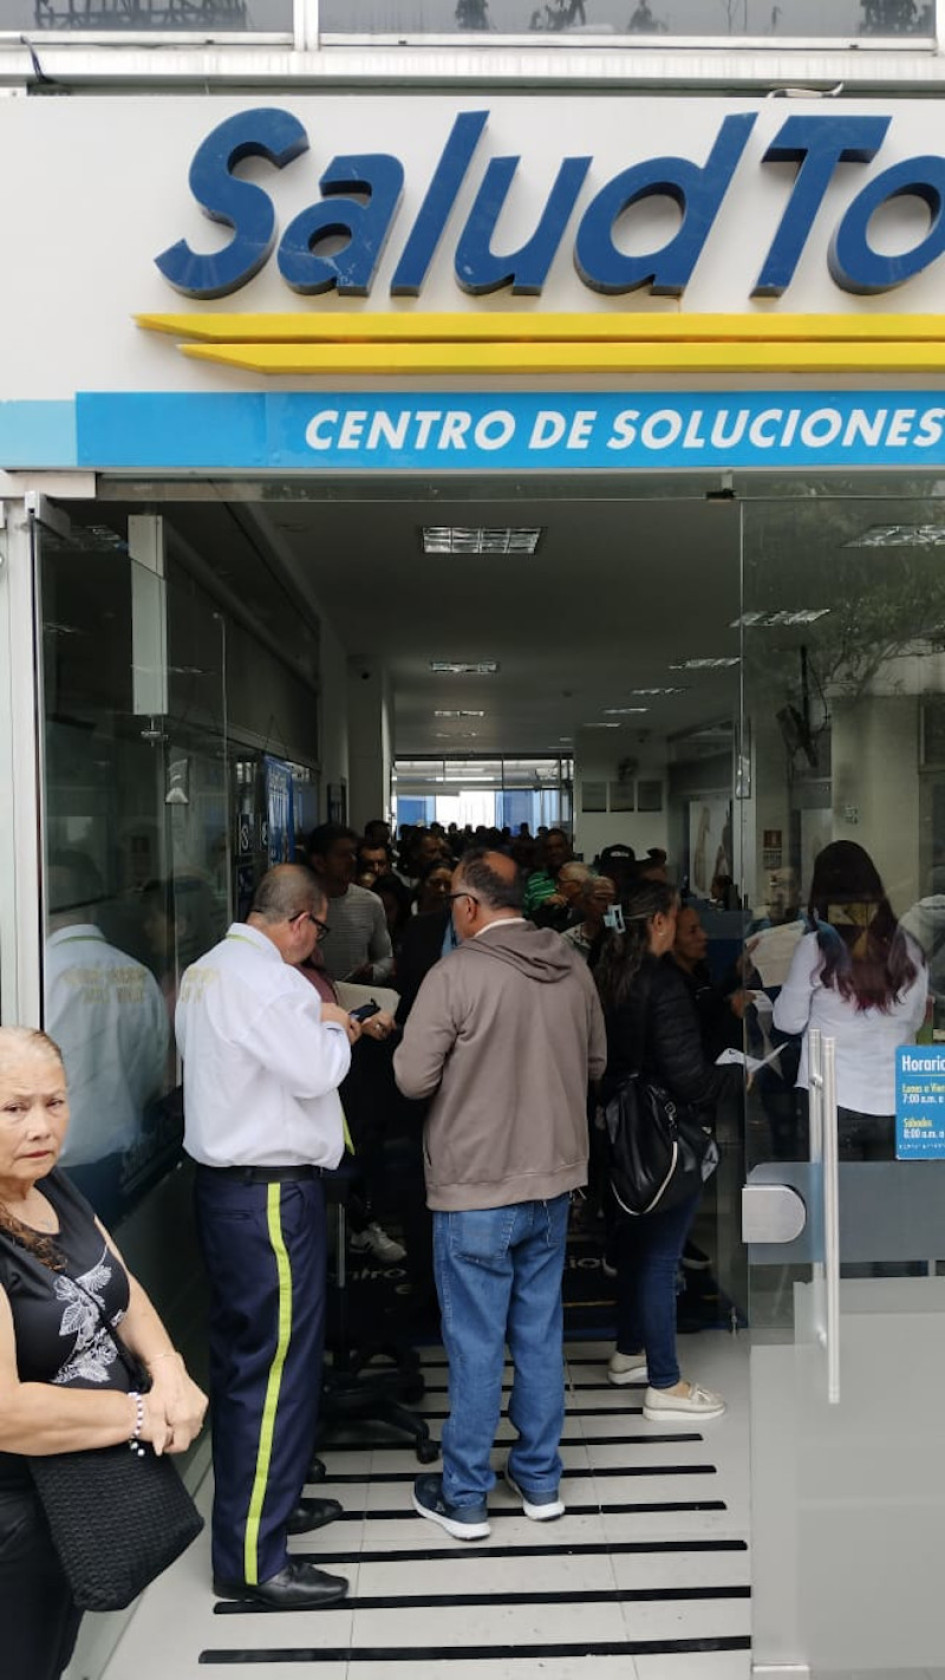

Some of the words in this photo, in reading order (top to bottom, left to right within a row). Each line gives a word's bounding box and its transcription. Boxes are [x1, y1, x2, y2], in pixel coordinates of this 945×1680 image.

[305, 410, 515, 450] CENTRO
[528, 411, 597, 449] DE
[607, 408, 945, 448] SOLUCIONES
